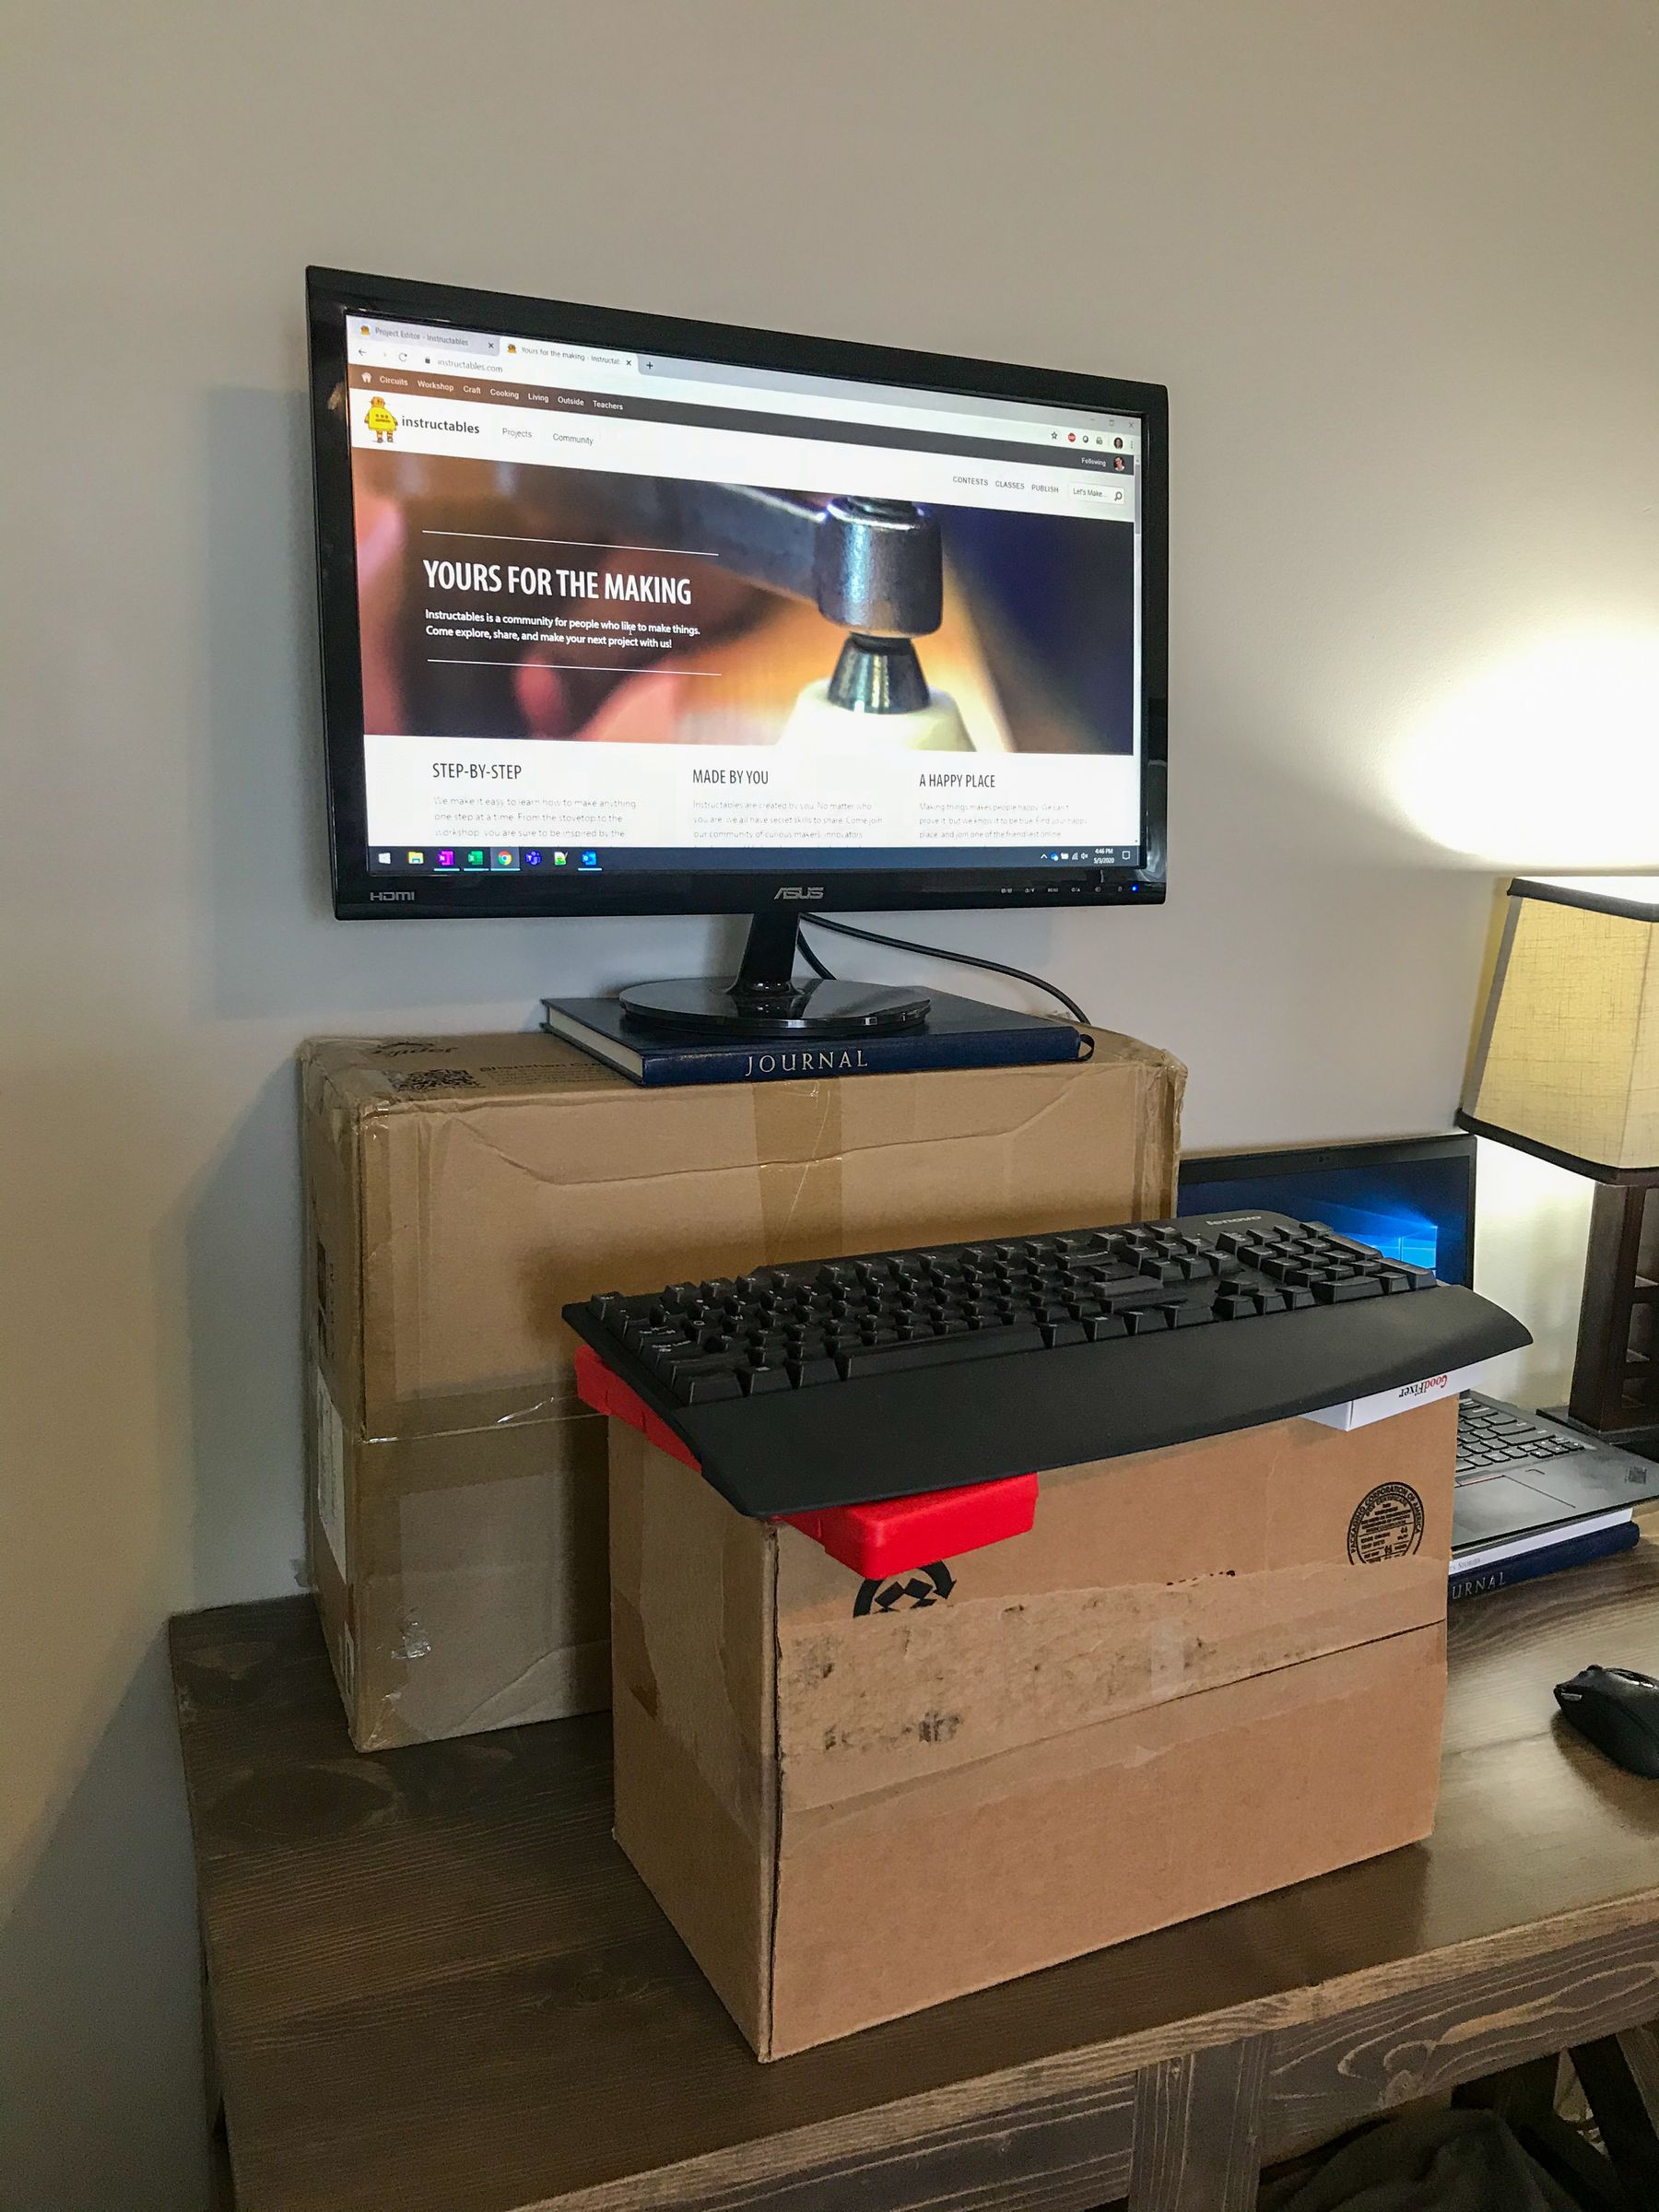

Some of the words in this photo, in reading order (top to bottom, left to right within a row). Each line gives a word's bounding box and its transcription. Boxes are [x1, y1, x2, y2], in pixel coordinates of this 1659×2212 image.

[375, 327, 399, 338] Project
[400, 330, 420, 340] Editor
[427, 335, 469, 346] Instructables
[522, 347, 538, 355] Yours
[550, 349, 560, 358] the
[562, 352, 584, 361] making
[438, 359, 503, 372] instructables.com
[380, 375, 408, 386] Circuits
[418, 380, 453, 393] Workshop
[463, 384, 481, 395] Craft
[490, 389, 519, 400] Cooking
[527, 393, 549, 404] Living
[558, 396, 584, 406] Outside
[593, 400, 623, 411] Teachers
[402, 416, 480, 434] instructables
[502, 428, 533, 439] Projects
[553, 433, 594, 446] Community
[1081, 457, 1106, 467] Following
[953, 476, 988, 486] CONTESTS
[995, 480, 1025, 490] CLASSES
[1031, 484, 1059, 493] PUBLISH
[422, 559, 502, 593] YOURS
[508, 565, 553, 596] FOR
[555, 570, 599, 599] THE
[605, 573, 691, 605] MAKING
[426, 608, 485, 623] Instructables
[486, 613, 494, 623] is
[502, 616, 553, 629] community
[555, 618, 568, 627] for
[569, 619, 599, 630] people
[601, 620, 620, 630] who
[621, 621, 636, 631] like
[638, 623, 647, 632] to
[648, 623, 671, 634] make
[673, 625, 700, 637] things.
[426, 625, 453, 636] Come
[455, 628, 492, 640] explore,
[493, 629, 520, 641] share,
[522, 631, 538, 641] and
[540, 632, 564, 642] make
[566, 634, 585, 645] your
[587, 635, 606, 644] next
[608, 636, 638, 648] project
[640, 638, 658, 648] with
[660, 640, 673, 649] us!
[432, 763, 522, 780] STEP-BY-STEP
[692, 769, 726, 784] MADE
[729, 771, 745, 784] BY
[746, 771, 769, 785] YOU
[919, 774, 926, 787] A
[929, 774, 964, 788] HAPPY
[966, 774, 995, 789] PLACE
[370, 891, 415, 901] HDMI
[774, 887, 824, 900] ASUS
[745, 1050, 868, 1077] JOURNAL
[1398, 1374, 1448, 1398] GoodFixer
[1365, 1485, 1408, 1506] CORPORATION
[1407, 1493, 1416, 1501] OF
[1452, 1571, 1506, 1600] URNAL
